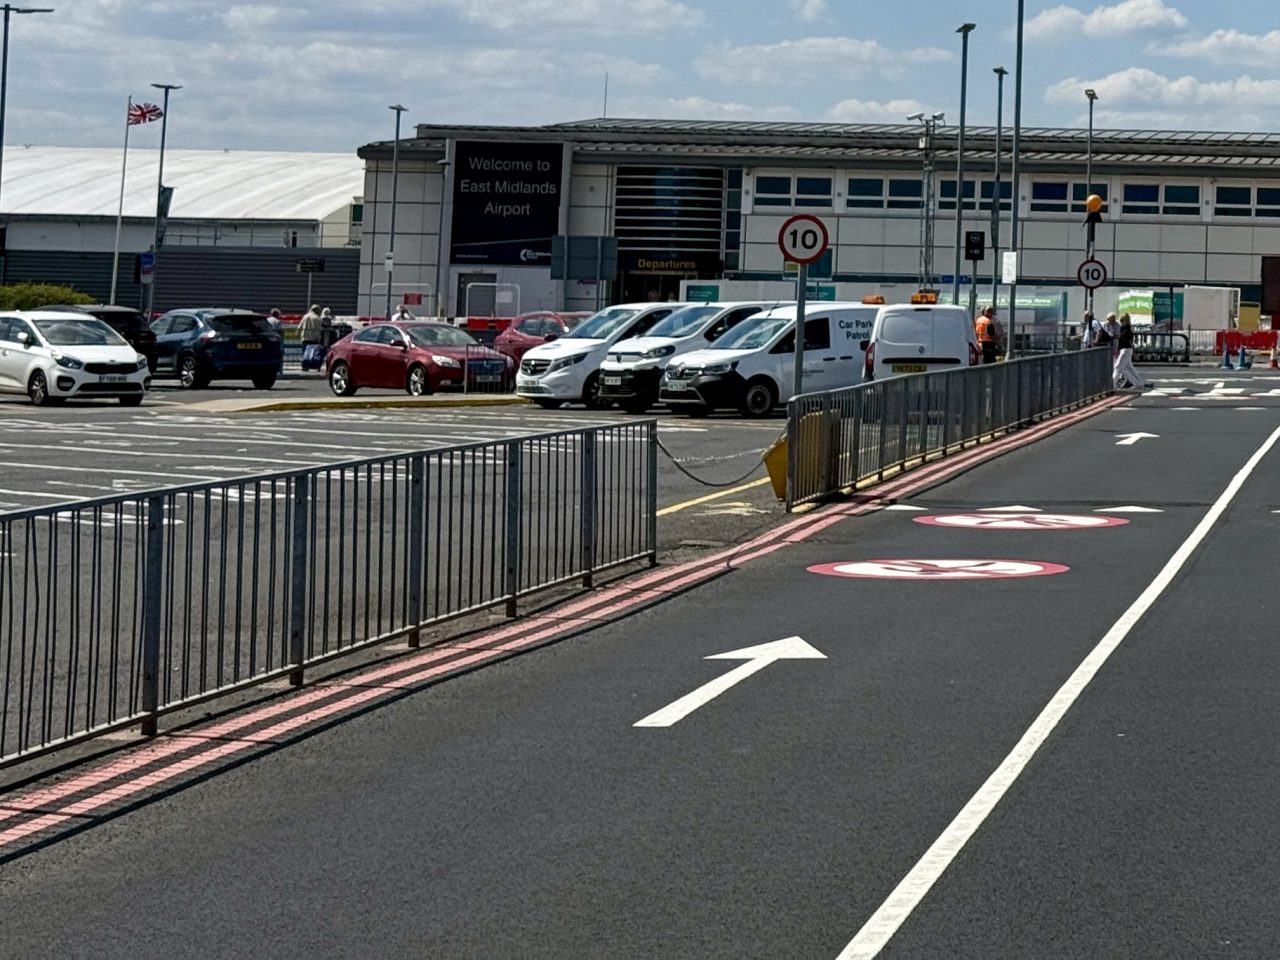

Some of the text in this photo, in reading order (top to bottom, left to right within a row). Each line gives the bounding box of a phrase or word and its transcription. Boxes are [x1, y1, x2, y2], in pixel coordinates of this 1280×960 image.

[468, 157, 551, 171] Welcome to
[461, 180, 556, 194] East Midlands
[484, 201, 530, 218] Airport
[790, 229, 818, 249] 10
[638, 259, 696, 270] Departures
[1085, 269, 1101, 281] 10
[838, 320, 874, 329] Car Park
[846, 331, 870, 340] Patrol
